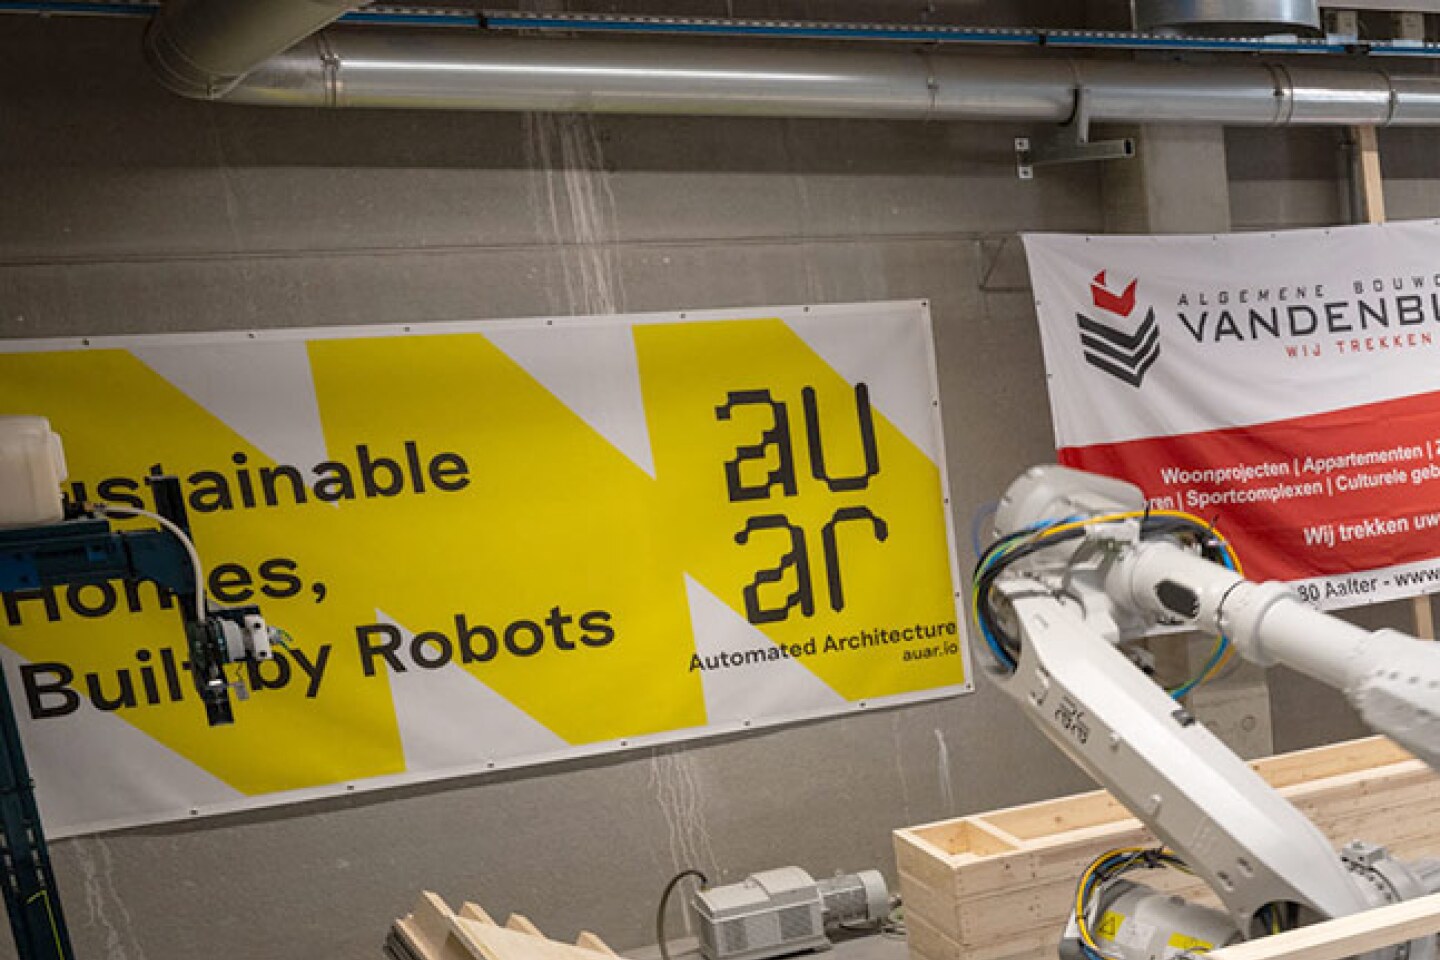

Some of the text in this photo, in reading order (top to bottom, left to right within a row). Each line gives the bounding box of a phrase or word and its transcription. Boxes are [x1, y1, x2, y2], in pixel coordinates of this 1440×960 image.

[1177, 285, 1324, 305] ALGEMENE
[1286, 344, 1321, 357] WIJ
[1336, 333, 1432, 352] TREKKEN
[1161, 461, 1289, 485] Woonprojecten
[1303, 445, 1423, 474] Appartementen
[1186, 480, 1323, 509] Sportcomplexen
[1335, 469, 1407, 491] Culturele
[1303, 524, 1335, 548] Wij
[1338, 517, 1409, 542] trekken
[1413, 512, 1440, 531] uw
[1325, 576, 1378, 599] Aalter
[20, 646, 196, 719] Buil
[355, 605, 615, 677] Robots
[690, 620, 958, 673] Automated Architecture
[903, 641, 958, 662] auar.io
